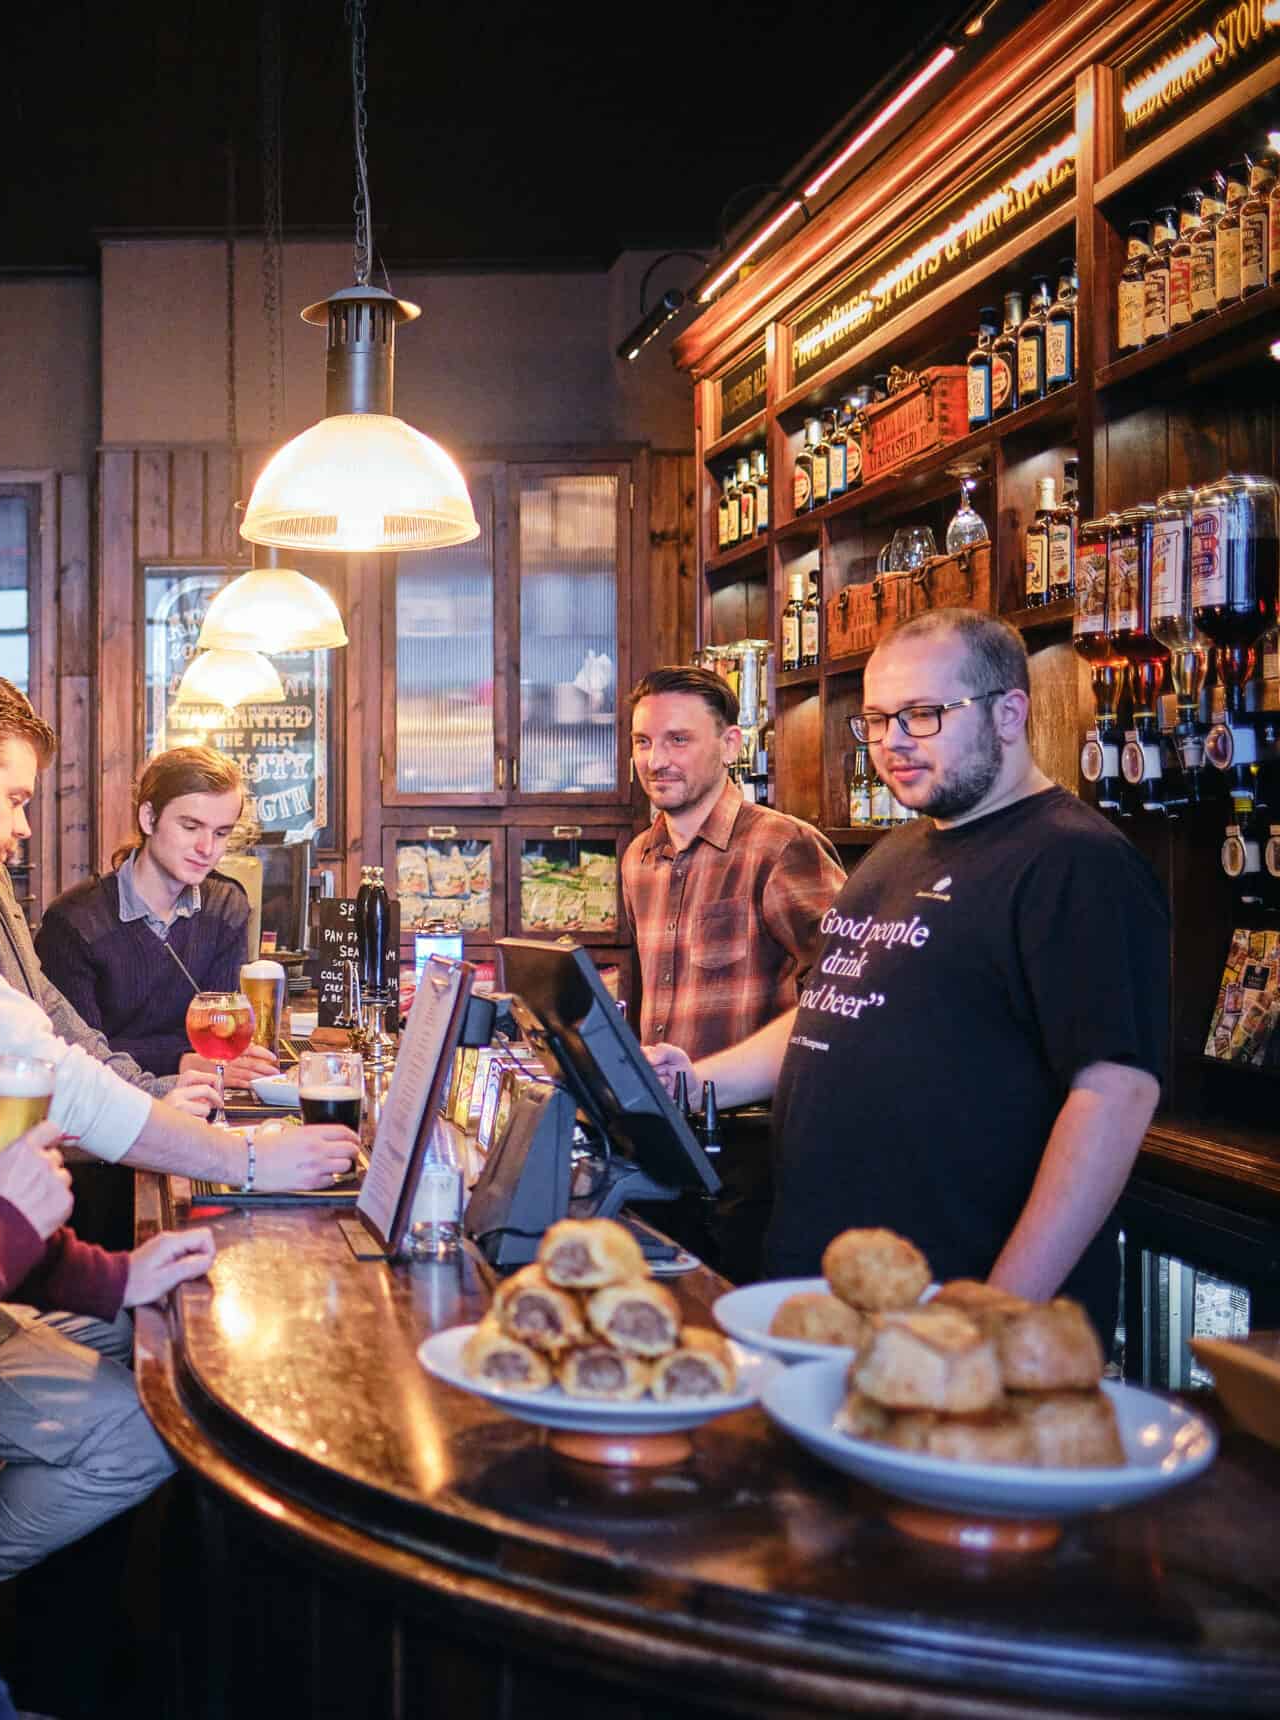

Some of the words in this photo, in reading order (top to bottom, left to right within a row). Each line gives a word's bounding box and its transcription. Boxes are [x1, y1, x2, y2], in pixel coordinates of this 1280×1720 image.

[215, 732, 245, 748] THE
[252, 732, 297, 748] FIRST
[324, 929, 343, 943] PAN
[820, 908, 872, 941] Good
[860, 915, 931, 949] people
[821, 948, 869, 978] drink
